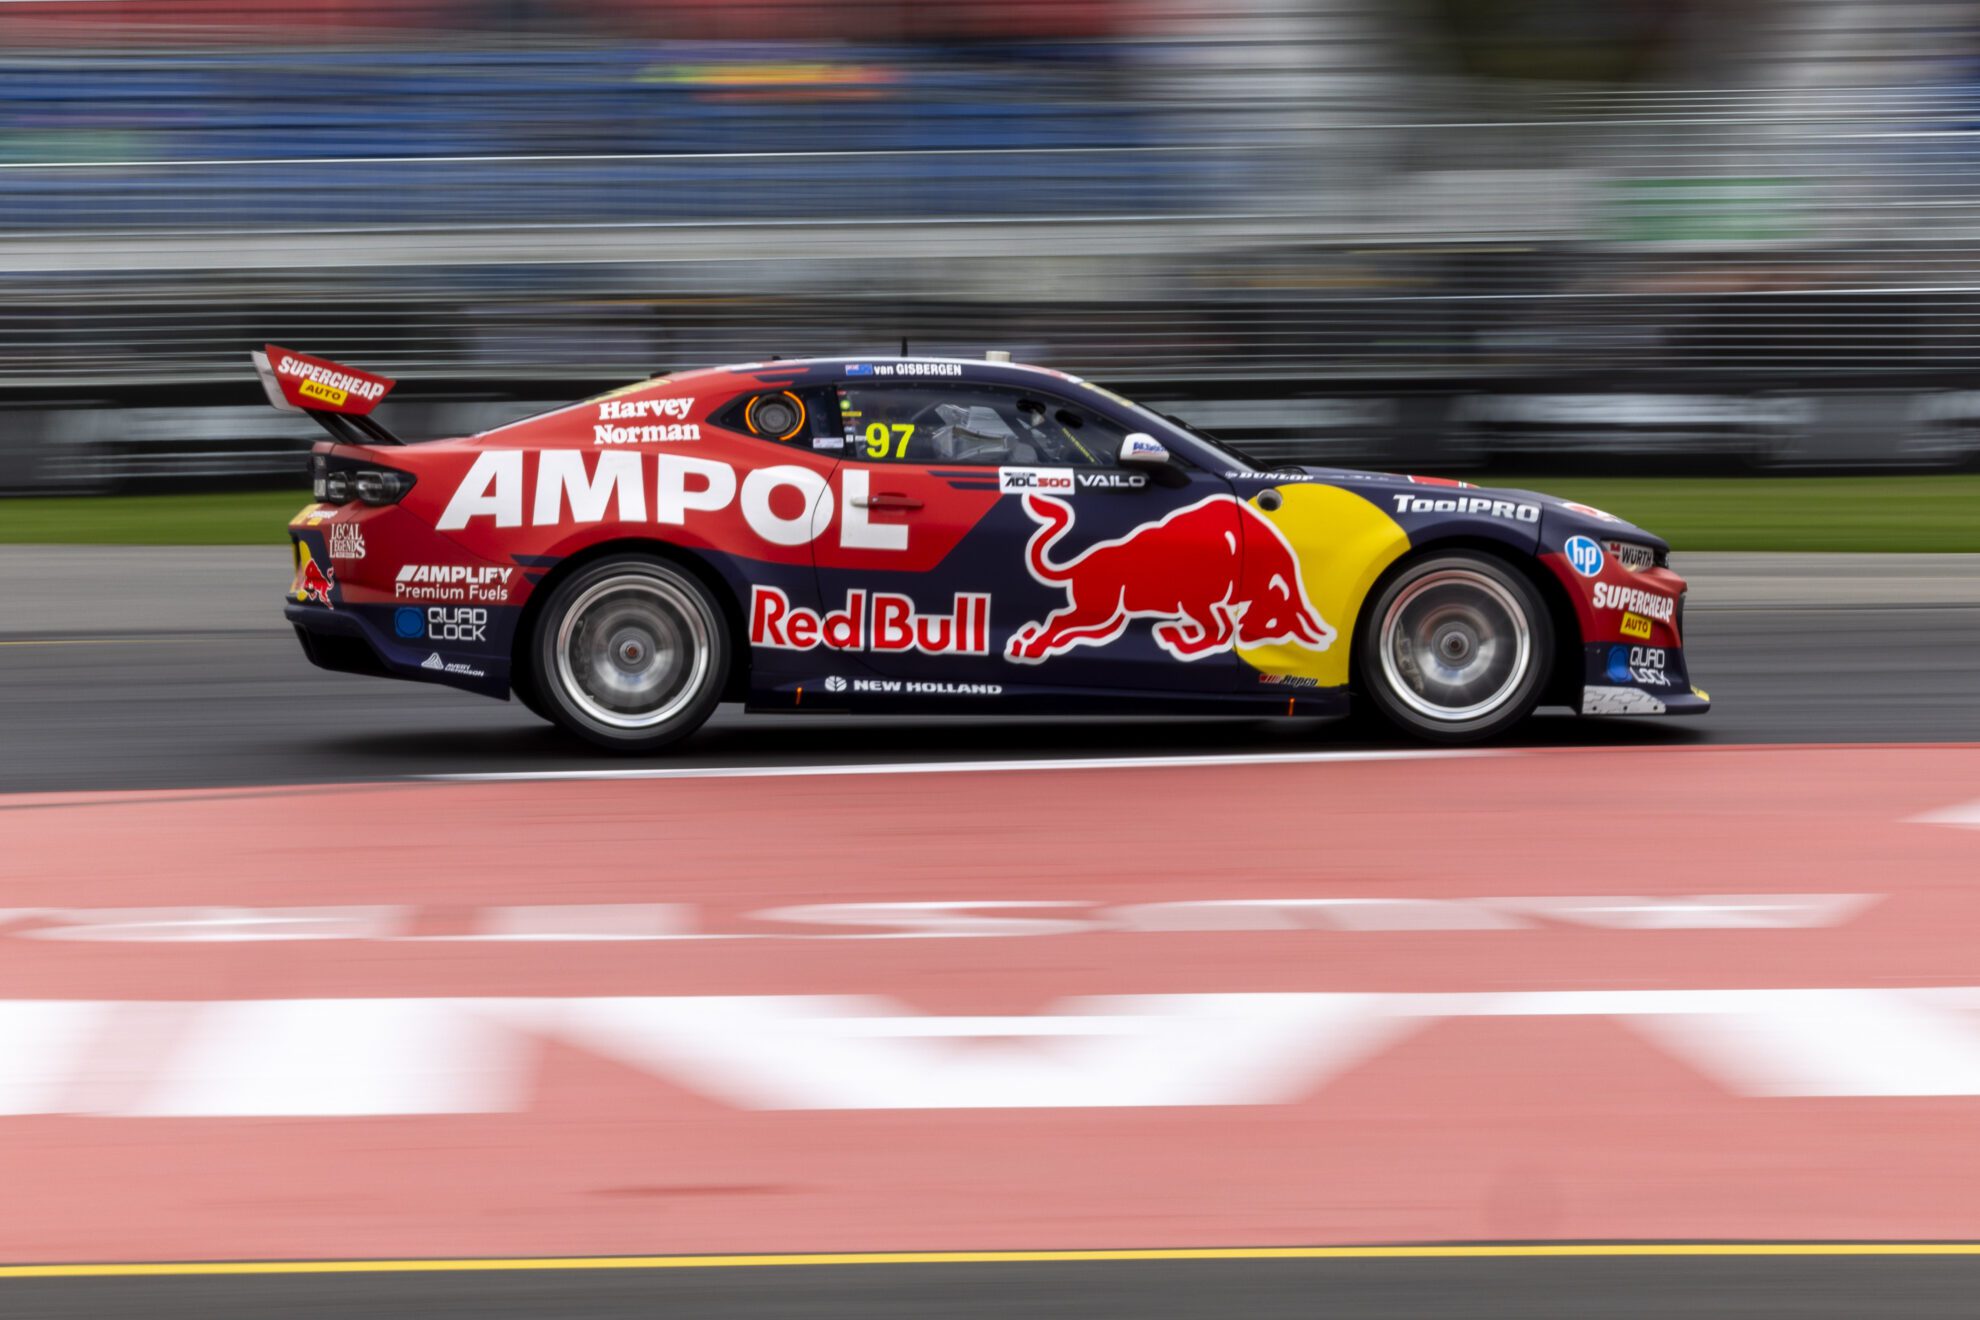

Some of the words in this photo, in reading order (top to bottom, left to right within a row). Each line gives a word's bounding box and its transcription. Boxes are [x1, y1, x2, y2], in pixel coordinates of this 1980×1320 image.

[278, 355, 385, 400] SUPERCHEAP
[873, 365, 894, 375] van
[896, 363, 962, 375] GISBERGEN
[305, 384, 341, 400] AUTO
[599, 398, 695, 420] Harvey
[593, 423, 701, 446] Norman
[866, 422, 915, 458] 97
[1077, 474, 1145, 488] VAILO
[1239, 472, 1314, 481] DUNLOP
[434, 449, 909, 550] AMPOL
[330, 523, 363, 541] LOCAL
[328, 539, 366, 560] LEGENDS
[1572, 537, 1597, 576] hp
[412, 565, 513, 584] AMPLIFY
[395, 583, 464, 600] Premium
[469, 585, 508, 600] Fuels
[1592, 581, 1674, 623] SUPERCHEAP
[427, 607, 487, 625] QUAD
[750, 585, 866, 651] Red
[870, 592, 992, 656] Bull
[1624, 617, 1649, 633] AUTO
[428, 624, 486, 642] LOCK
[1630, 647, 1665, 669] QUAD
[853, 680, 901, 691] NEW
[906, 682, 1003, 694] HOLLAND
